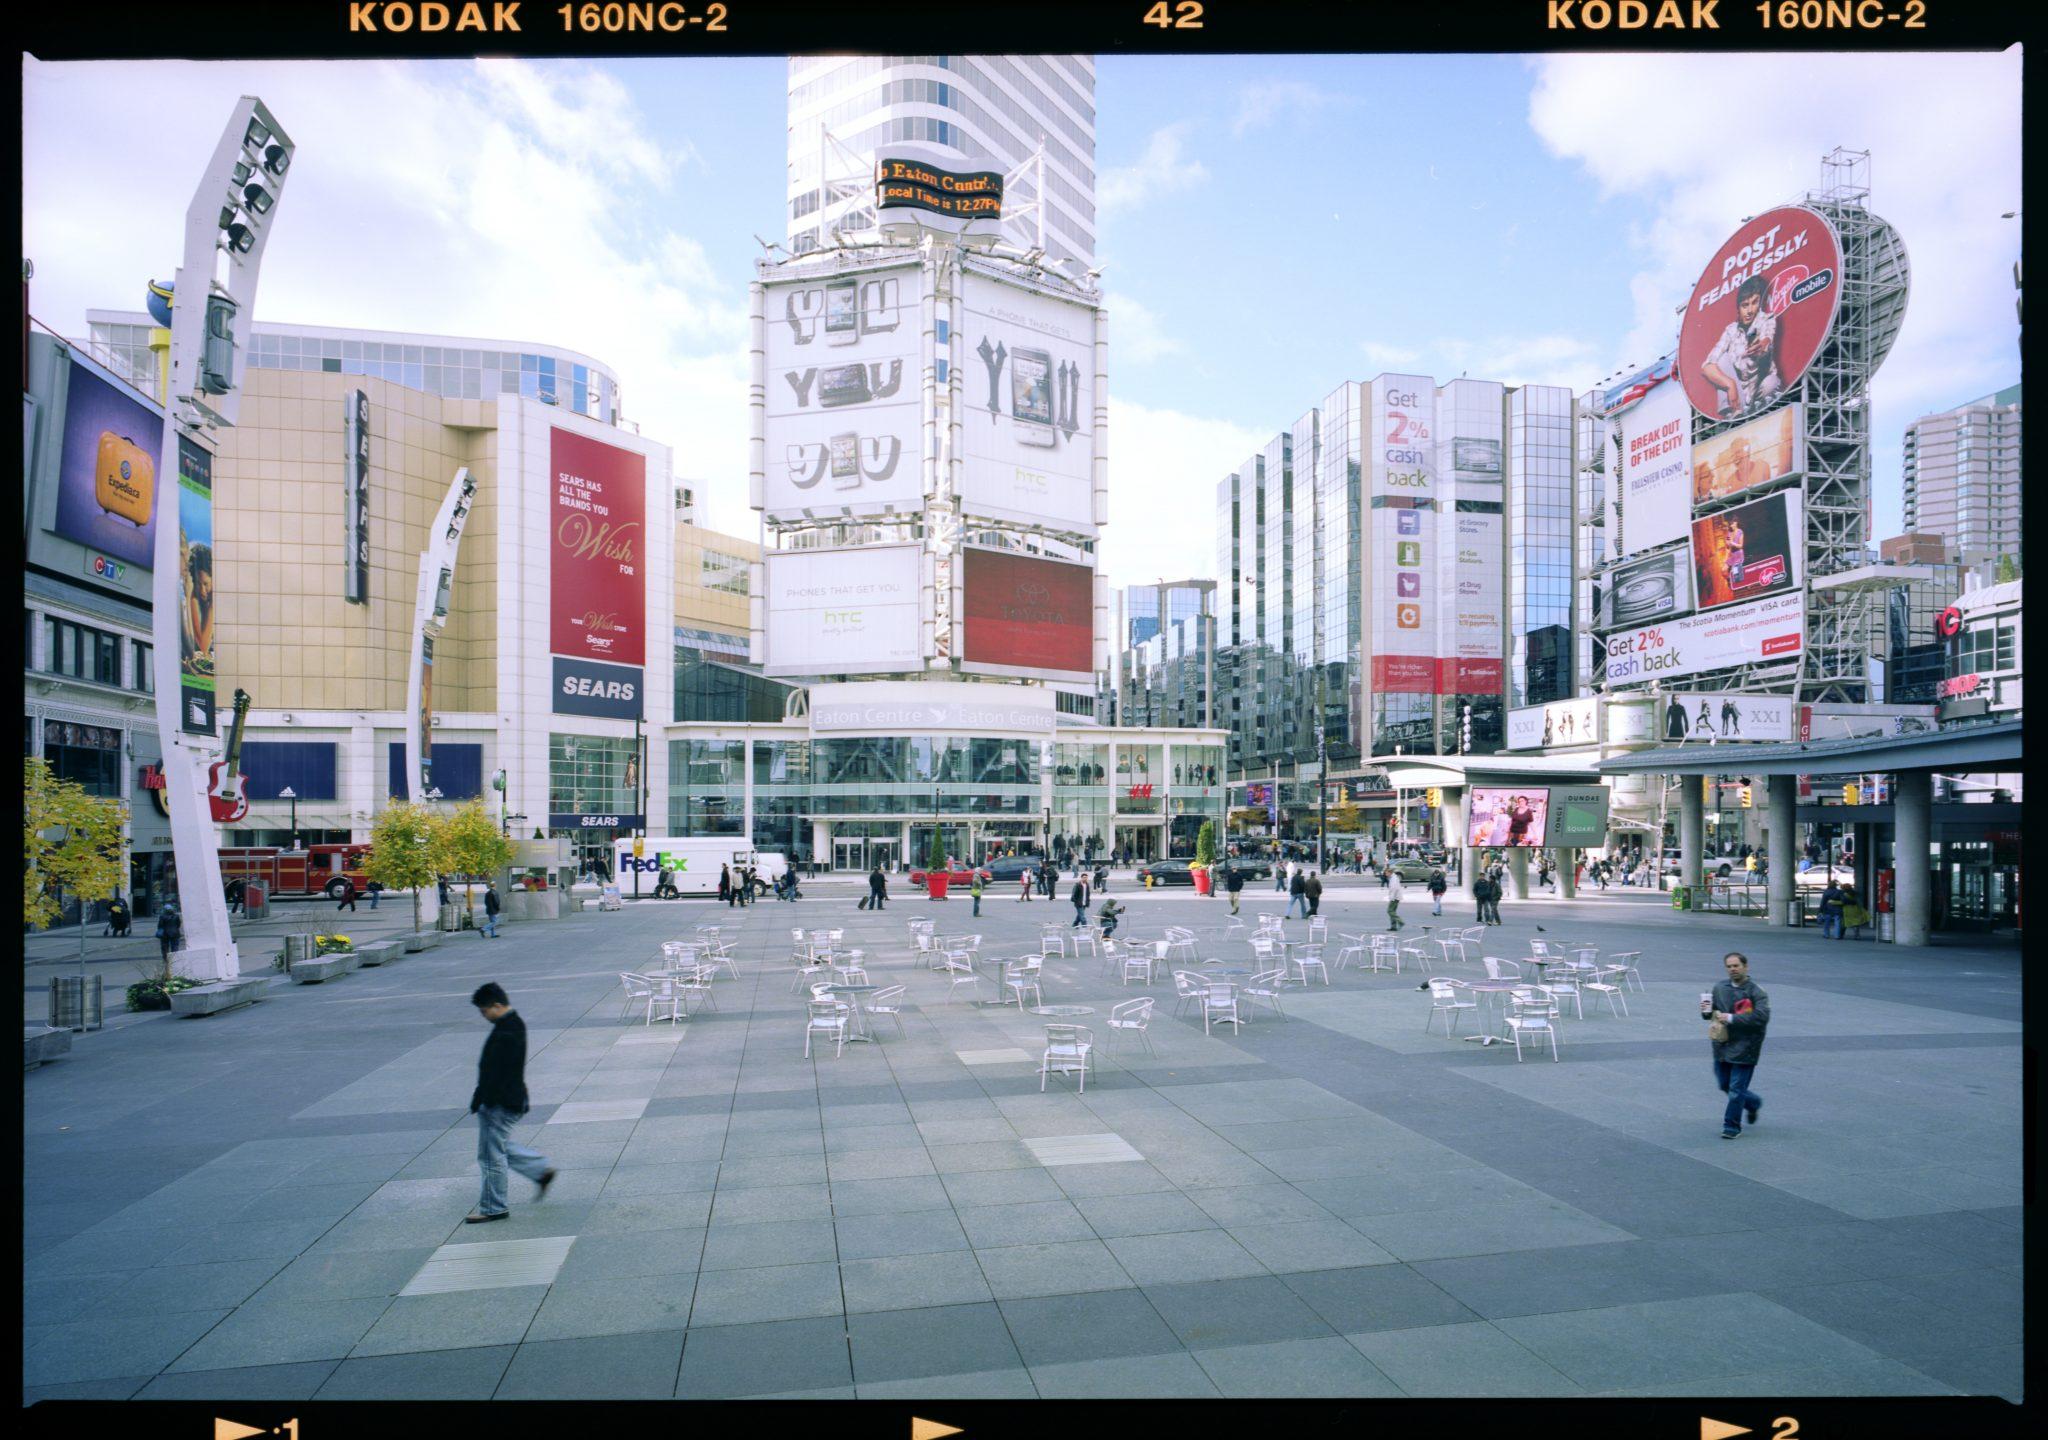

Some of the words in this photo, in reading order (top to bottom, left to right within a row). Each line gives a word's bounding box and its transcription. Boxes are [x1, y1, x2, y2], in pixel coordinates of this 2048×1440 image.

[350, 2, 522, 32] KODAK
[557, 2, 728, 32] 160NC-2
[1143, 1, 1204, 28] 42
[1548, 0, 1721, 29] KODAK
[1756, 0, 1927, 28] 160NC-2
[892, 163, 938, 186] Eaton
[916, 188, 940, 207] Time
[942, 200, 952, 211] is
[1722, 224, 1781, 279] POST
[1698, 229, 1809, 312] FEARLESSLY.
[1768, 274, 1799, 312] Virgin
[1795, 274, 1827, 299] mobile
[997, 308, 1026, 324] PHONE
[1028, 317, 1049, 331] THAT
[1386, 389, 1418, 408] Get
[1386, 411, 1429, 445] 2%
[1630, 428, 1661, 453] BREAK
[1662, 418, 1682, 438] OUT
[1386, 447, 1423, 465] cash
[1630, 453, 1642, 467] OF
[1643, 444, 1661, 461] THE
[1662, 433, 1684, 454] CITY
[360, 399, 368, 564] SEARS
[559, 472, 585, 488] SEARS
[586, 481, 602, 492] HAS
[1015, 467, 1046, 486] htc
[1386, 467, 1427, 488] back
[559, 484, 574, 497] ALL
[576, 488, 591, 501] THE
[559, 495, 591, 512] BRANDS
[593, 504, 608, 516] YOU
[558, 512, 640, 562] Wish
[95, 557, 126, 581] CTV
[619, 564, 634, 576] FOR
[786, 586, 827, 598] PHONES
[830, 585, 853, 595] THAT
[856, 584, 875, 594] GET
[1466, 581, 1482, 589] Drug
[1657, 598, 1672, 608] VISA
[825, 610, 863, 624] htc
[1679, 621, 1692, 630] The
[1692, 616, 1713, 628] Scotia
[1714, 607, 1756, 623] Momentum
[1760, 602, 1779, 614] VISA
[586, 634, 611, 647] Sears
[1607, 635, 1634, 657] Get
[1637, 628, 1665, 652] 2%
[1607, 655, 1639, 679] cash
[1643, 646, 1682, 672] back
[562, 676, 635, 701] SEARS
[815, 709, 859, 725] Eaton
[865, 708, 922, 723] Centre
[959, 709, 1004, 725] Eaton
[1010, 711, 1052, 728] Centre
[1513, 720, 1535, 735] XXI
[1750, 710, 1781, 723] XXI
[1129, 783, 1153, 800] H&M
[1567, 794, 1600, 802] DUNDAS
[581, 816, 619, 827] SEARS
[1555, 806, 1563, 833] YONGE
[1567, 825, 1596, 833] SQUARE
[620, 851, 688, 873] FedEx
[1771, 1416, 1800, 1440] 2
